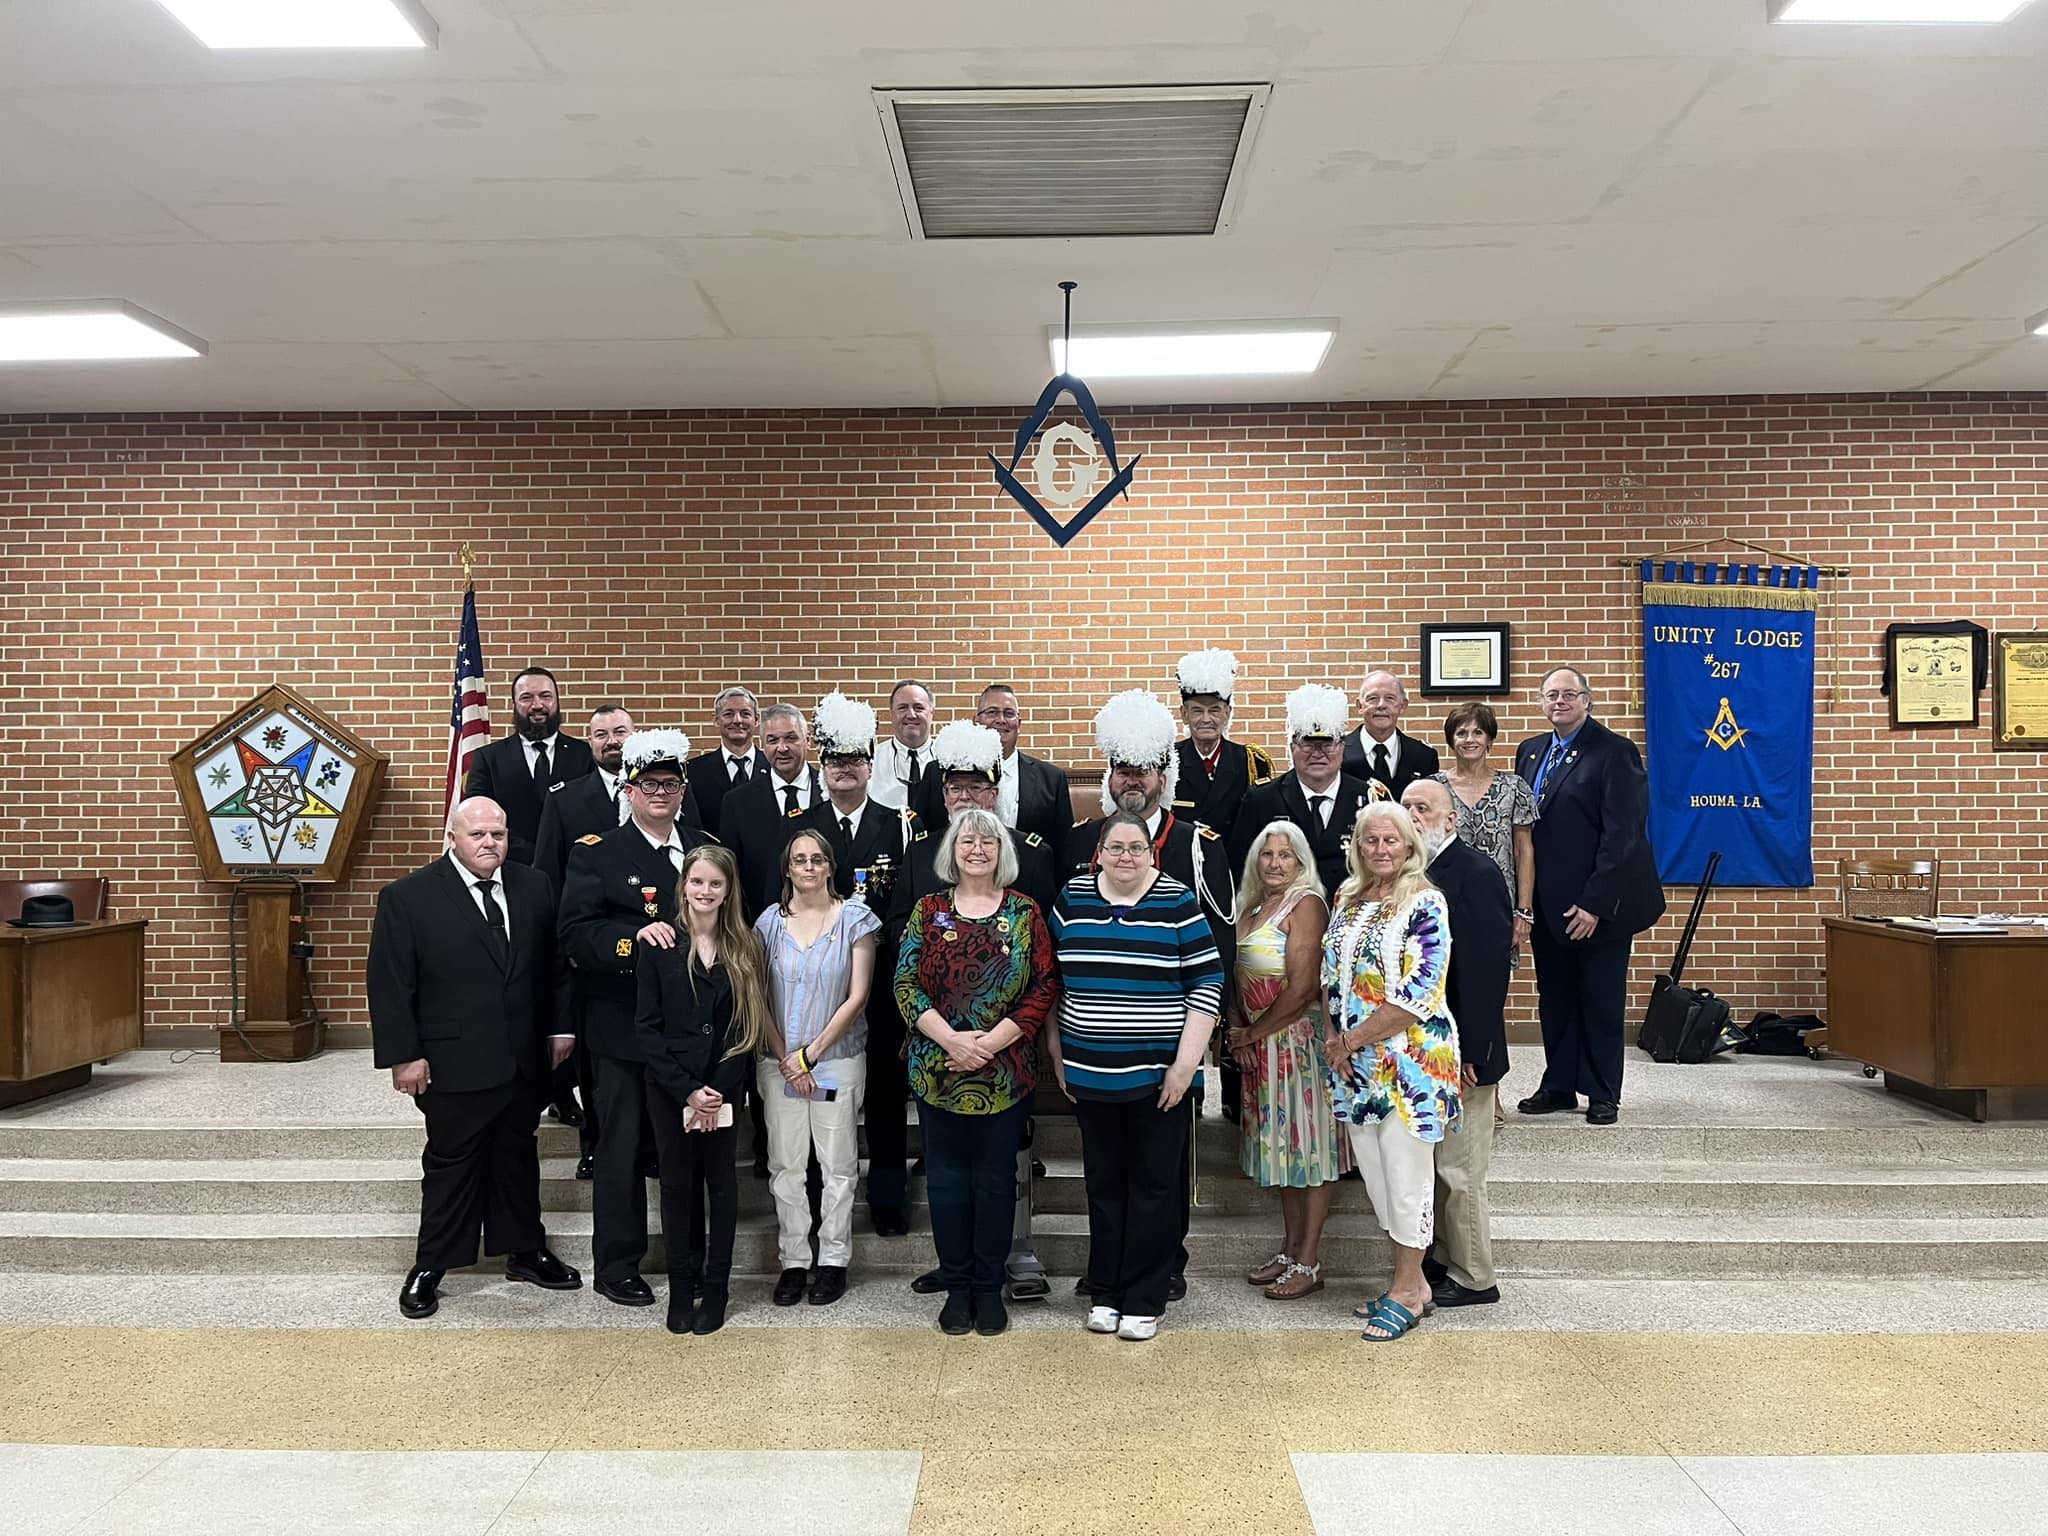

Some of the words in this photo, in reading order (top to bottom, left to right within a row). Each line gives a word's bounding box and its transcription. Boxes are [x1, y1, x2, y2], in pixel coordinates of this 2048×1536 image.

[1032, 421, 1102, 505] G
[1654, 626, 1715, 644] UNITY
[1735, 629, 1803, 648] LODGE
[1704, 653, 1740, 678] #267
